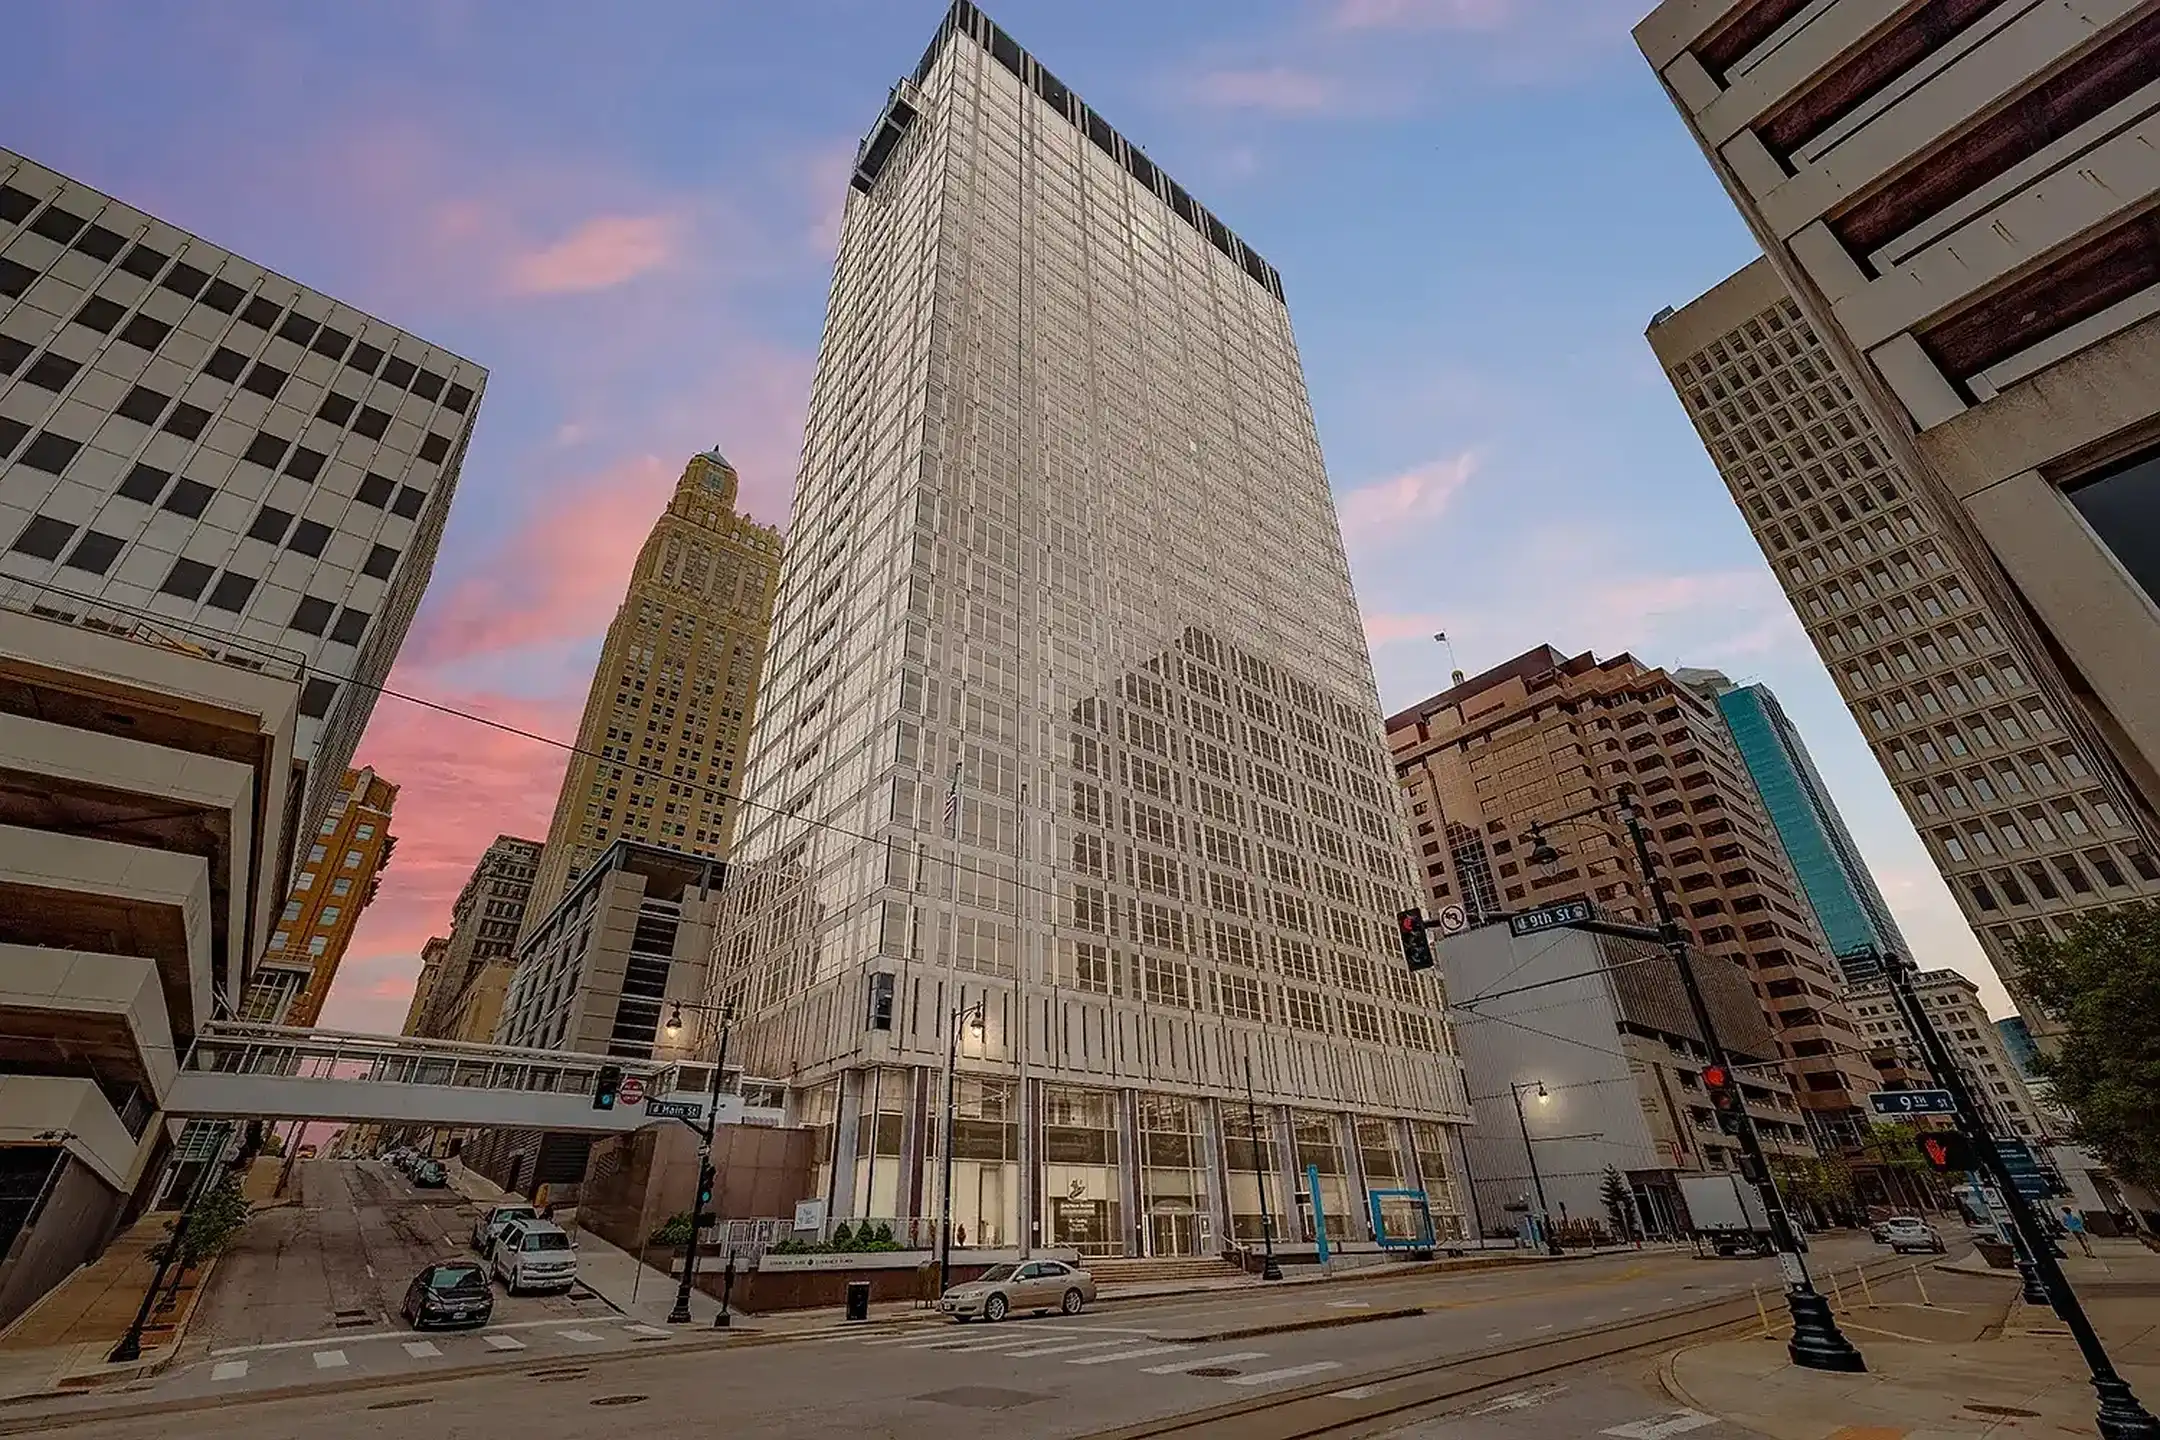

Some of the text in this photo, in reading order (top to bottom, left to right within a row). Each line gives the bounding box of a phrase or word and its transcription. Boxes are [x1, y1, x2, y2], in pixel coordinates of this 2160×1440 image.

[1529, 911, 1553, 927] 9th
[1556, 907, 1571, 921] St
[661, 1103, 684, 1117] Main
[687, 1105, 697, 1117] St
